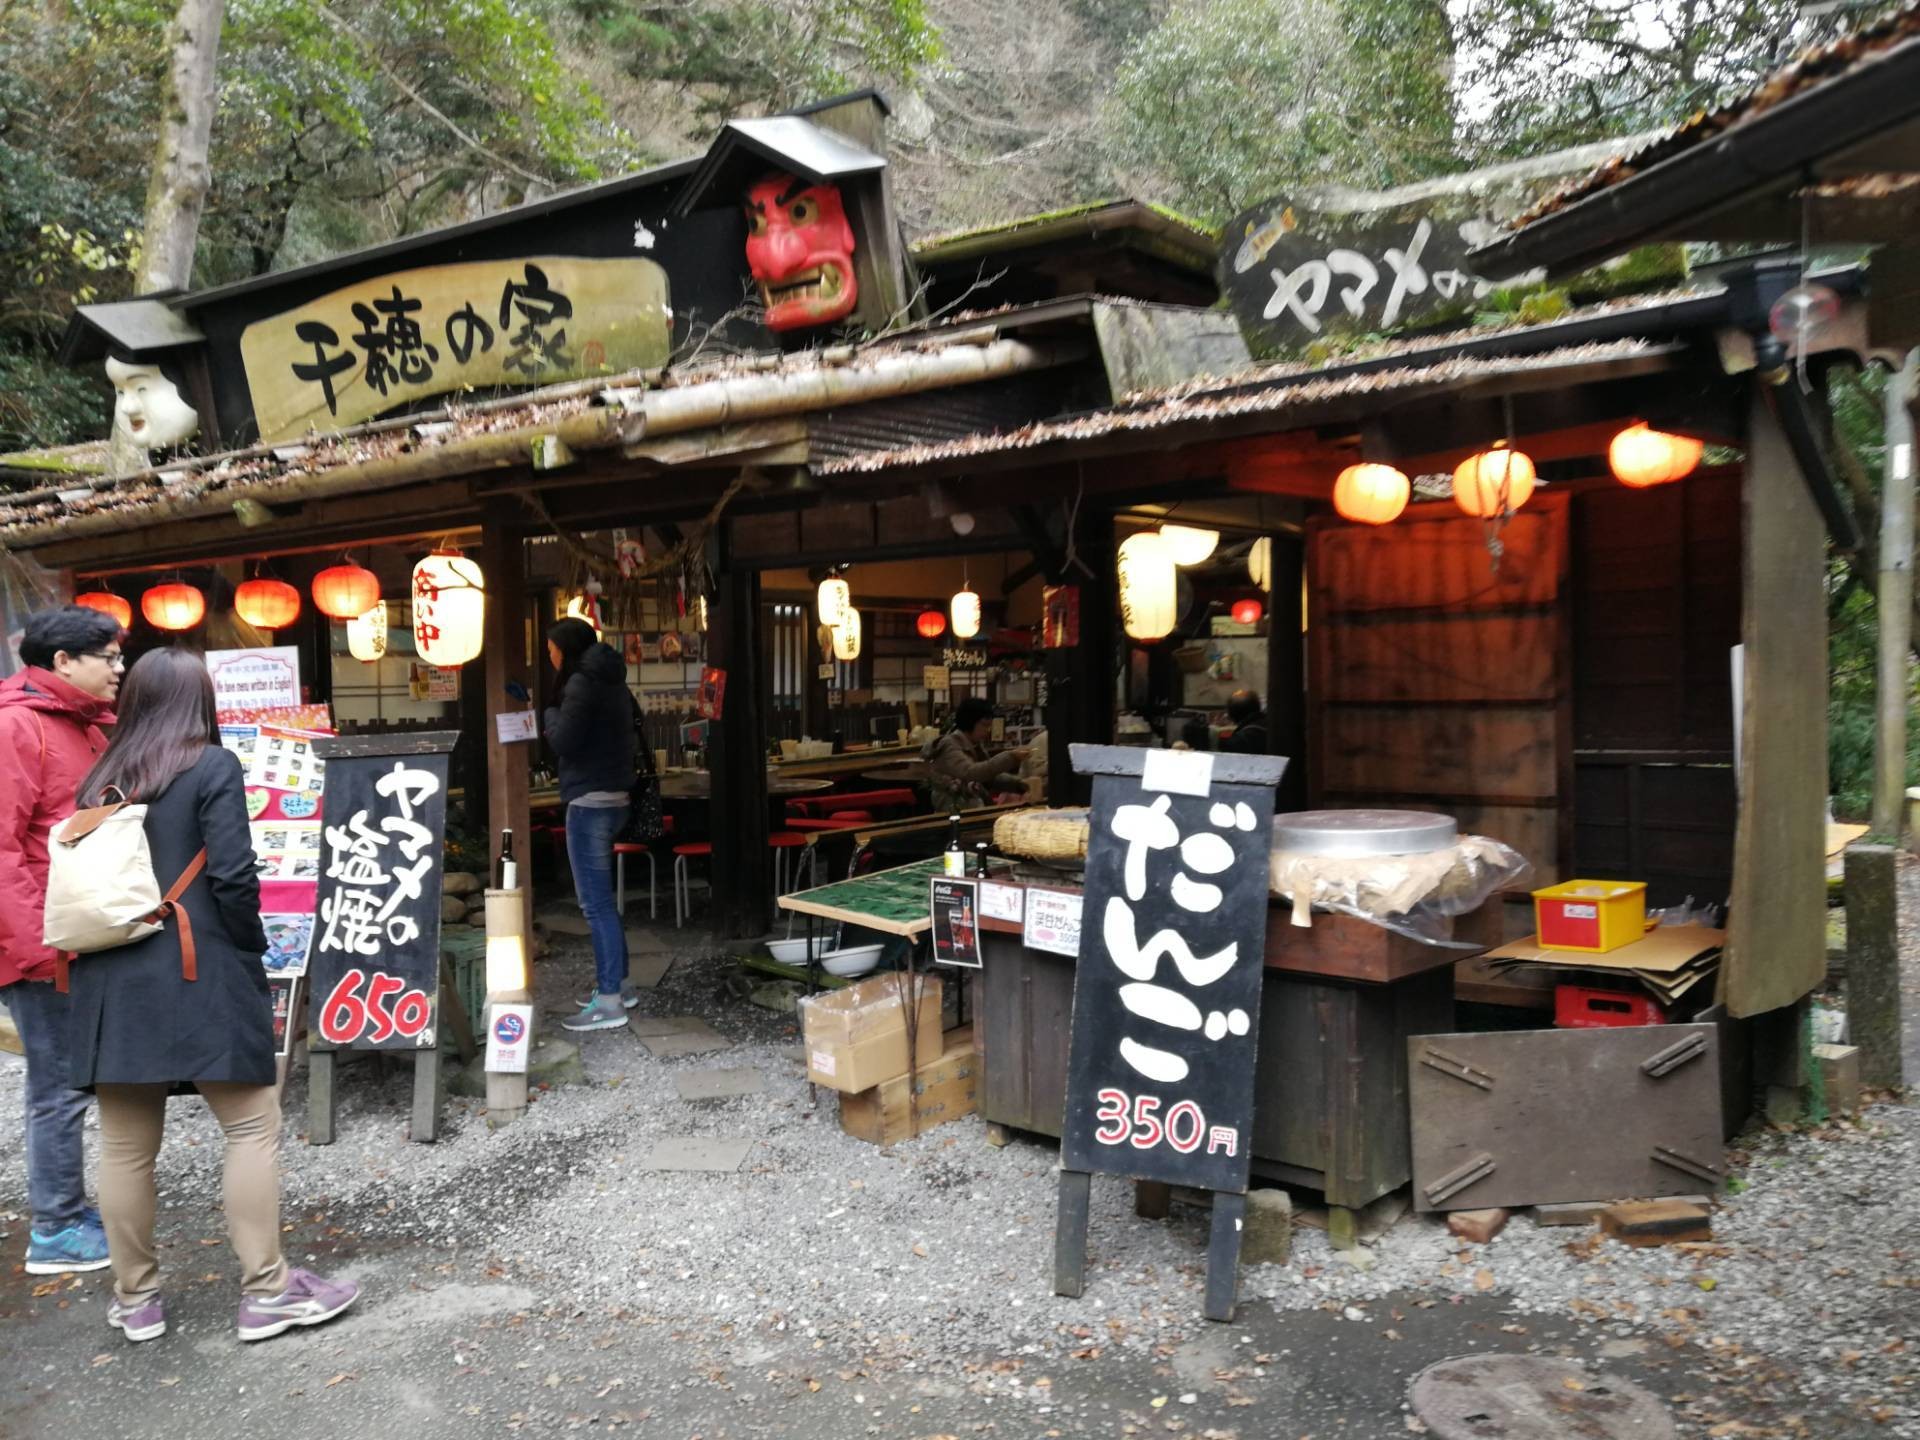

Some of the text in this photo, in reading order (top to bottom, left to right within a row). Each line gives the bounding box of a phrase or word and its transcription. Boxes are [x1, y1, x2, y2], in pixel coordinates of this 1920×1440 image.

[292, 263, 574, 416] 千穂の家
[1263, 216, 1548, 334] ヤマメの
[319, 809, 391, 956] 塩焼
[375, 761, 440, 946] ヤマメの
[1103, 794, 1258, 1083] だんご
[1095, 1088, 1238, 1157] 350円
